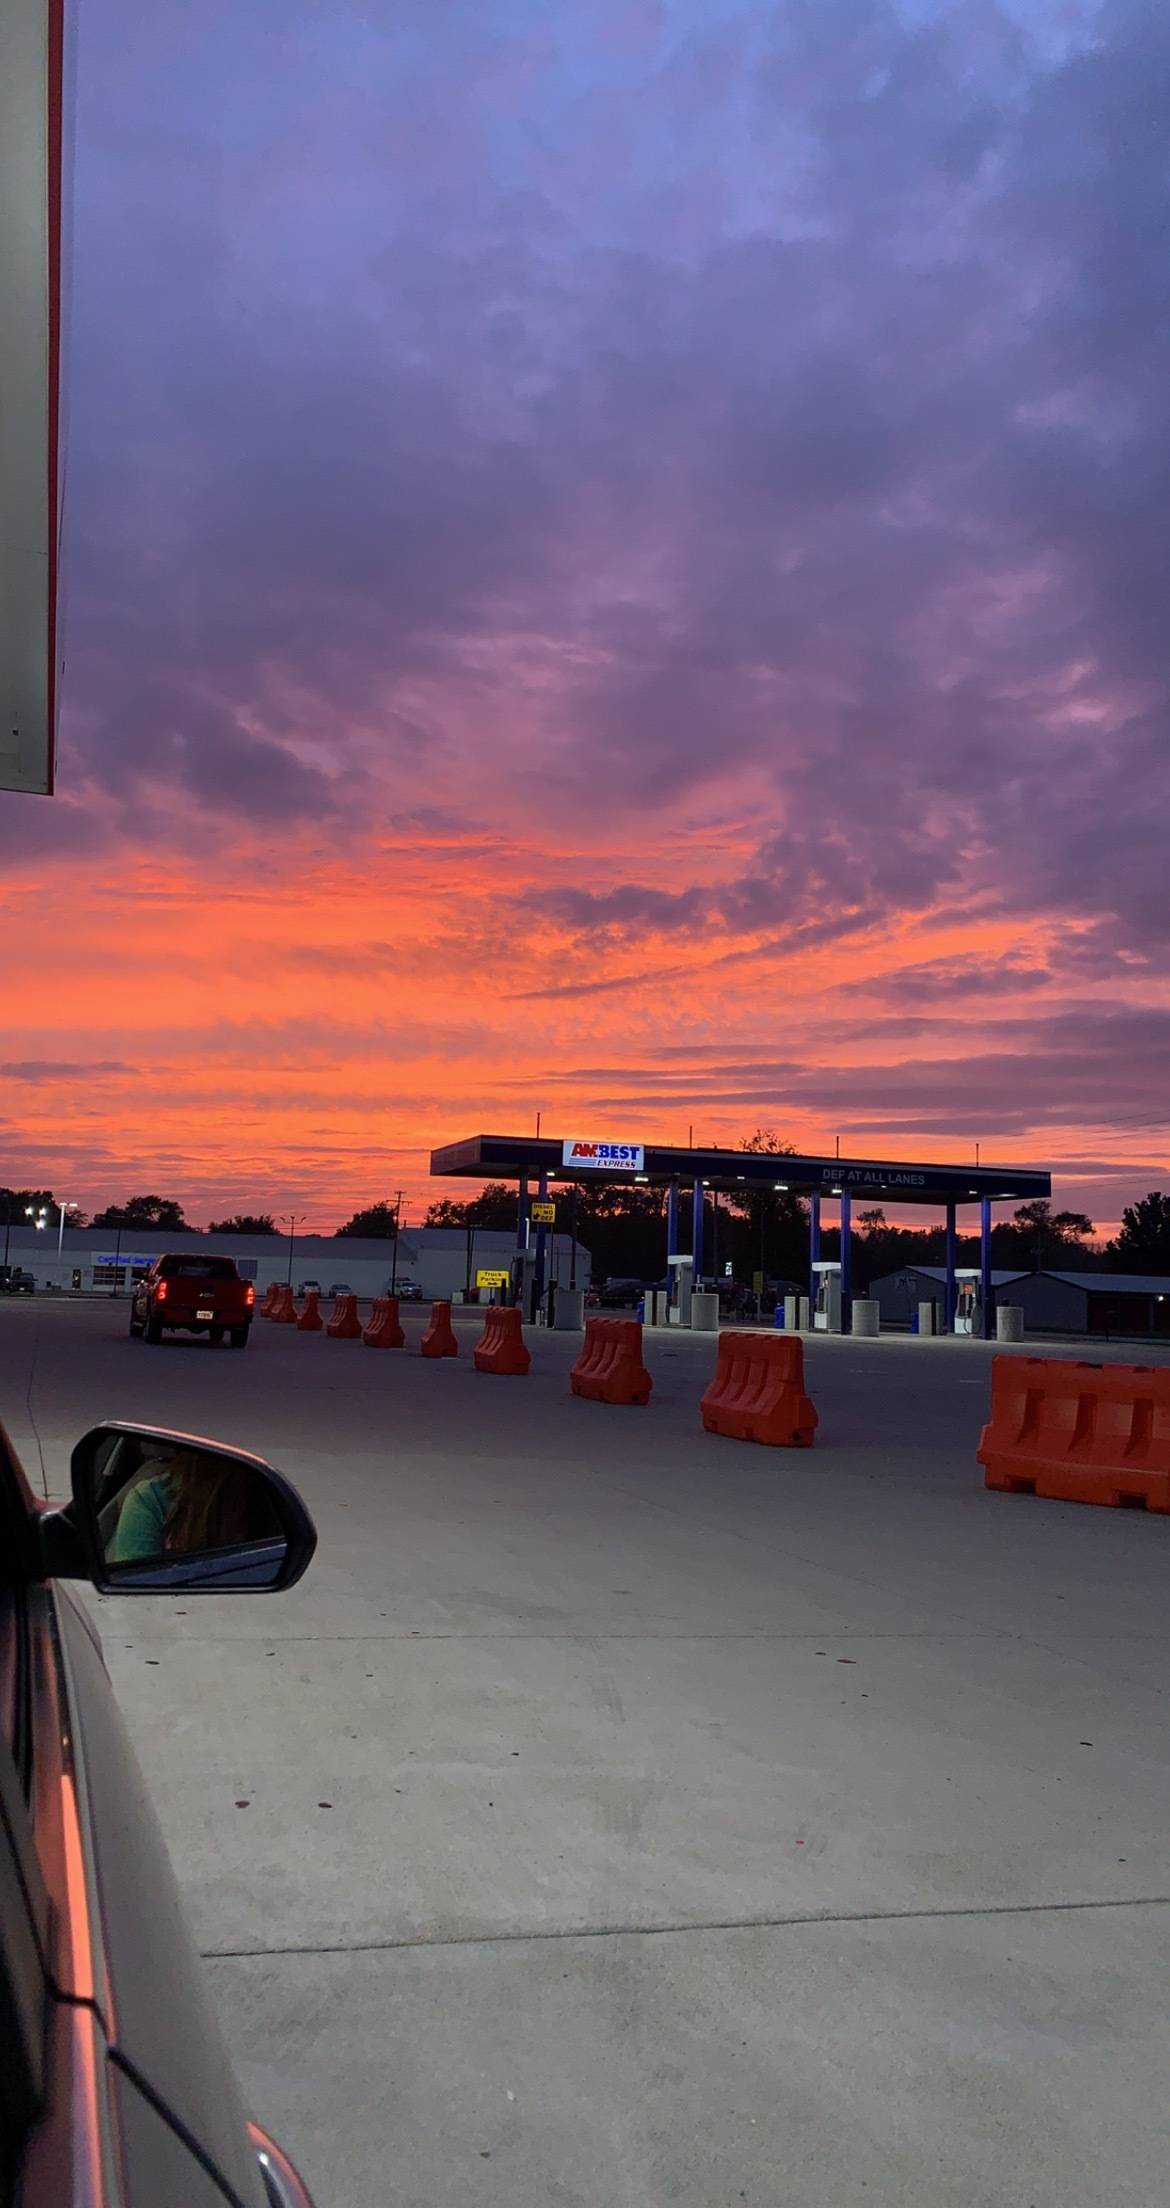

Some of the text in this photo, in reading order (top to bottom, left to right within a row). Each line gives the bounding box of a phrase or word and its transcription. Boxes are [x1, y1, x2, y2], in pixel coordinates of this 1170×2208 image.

[597, 1160, 636, 1169] EXPRESS
[823, 1168, 925, 1185] DEF AT ALL LANES
